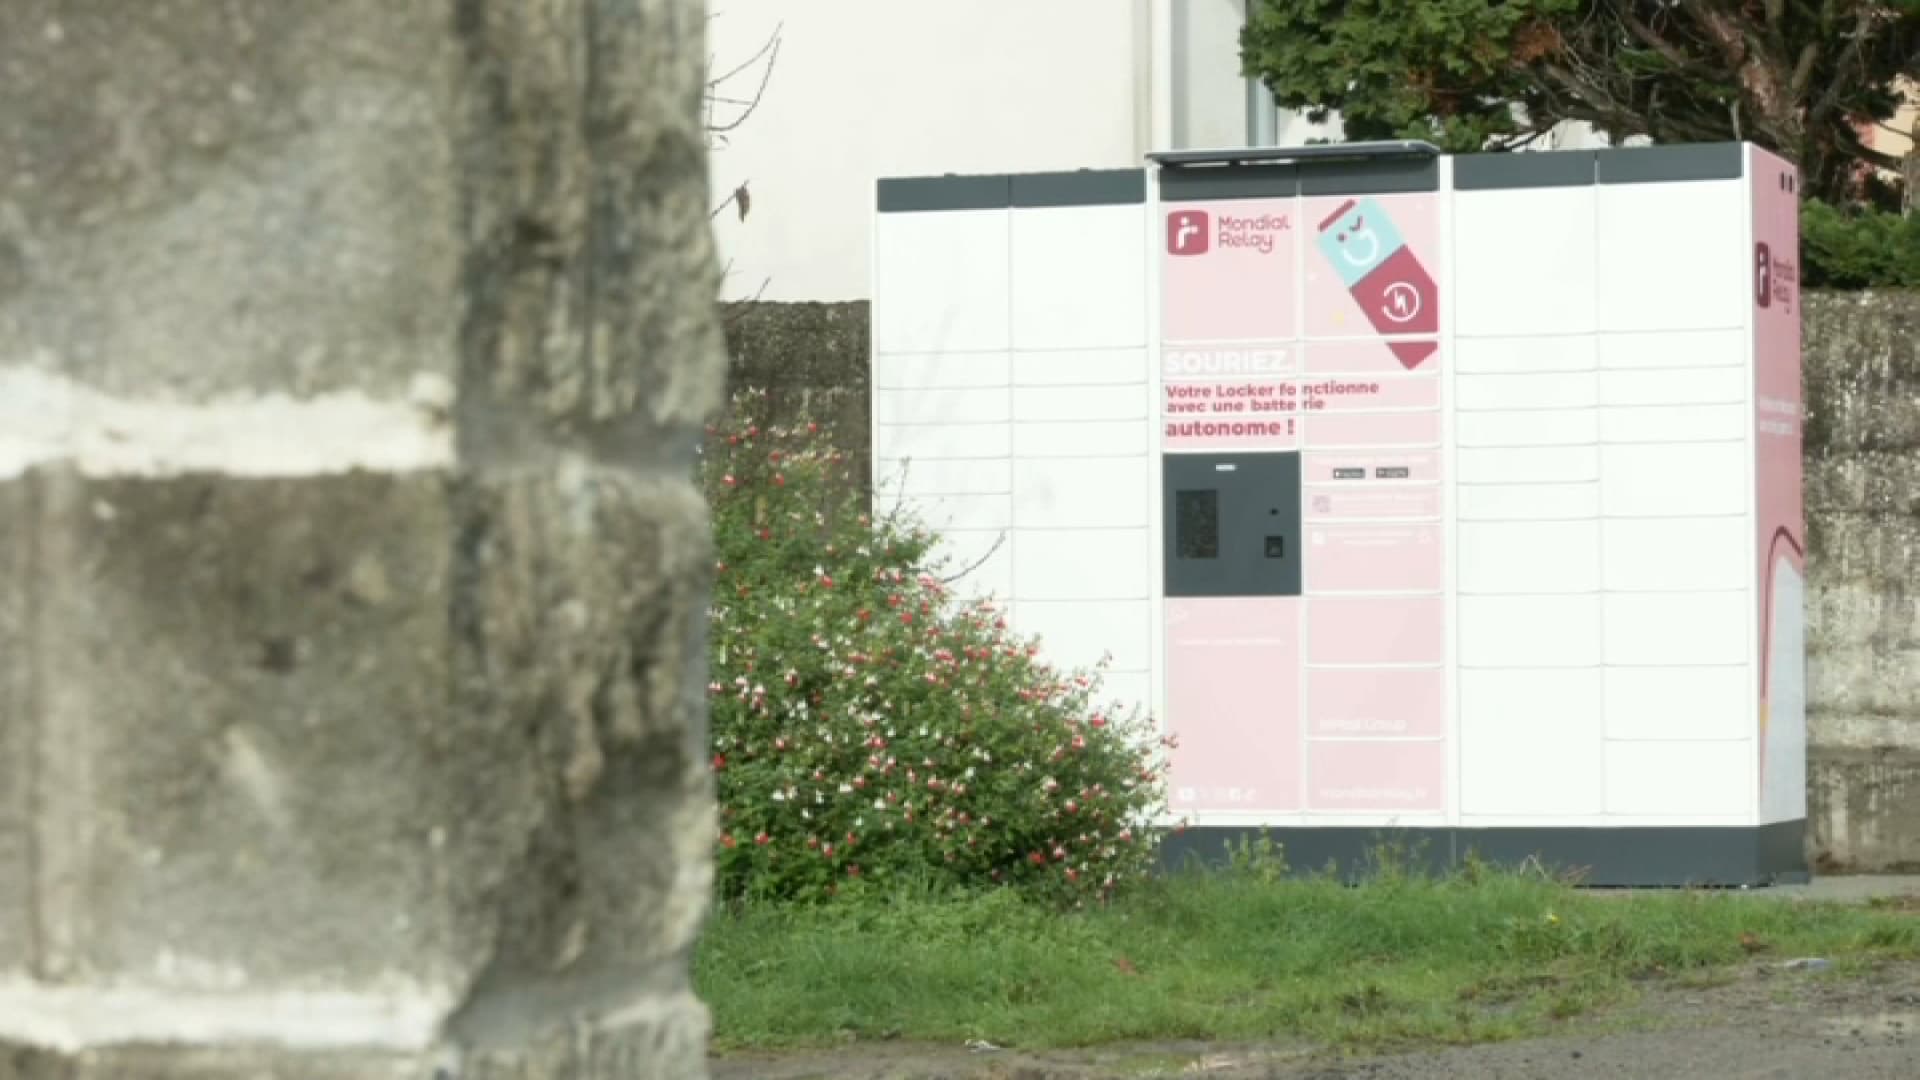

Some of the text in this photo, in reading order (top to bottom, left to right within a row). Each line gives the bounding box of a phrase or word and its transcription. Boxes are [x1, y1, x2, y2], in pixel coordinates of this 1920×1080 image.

[1218, 214, 1291, 231] Mondial
[1218, 232, 1273, 254] Relay
[1165, 379, 1380, 399] Votre Locker fonctionne
[1166, 395, 1326, 413] avec une batterie
[1165, 418, 1295, 437] autonome !
